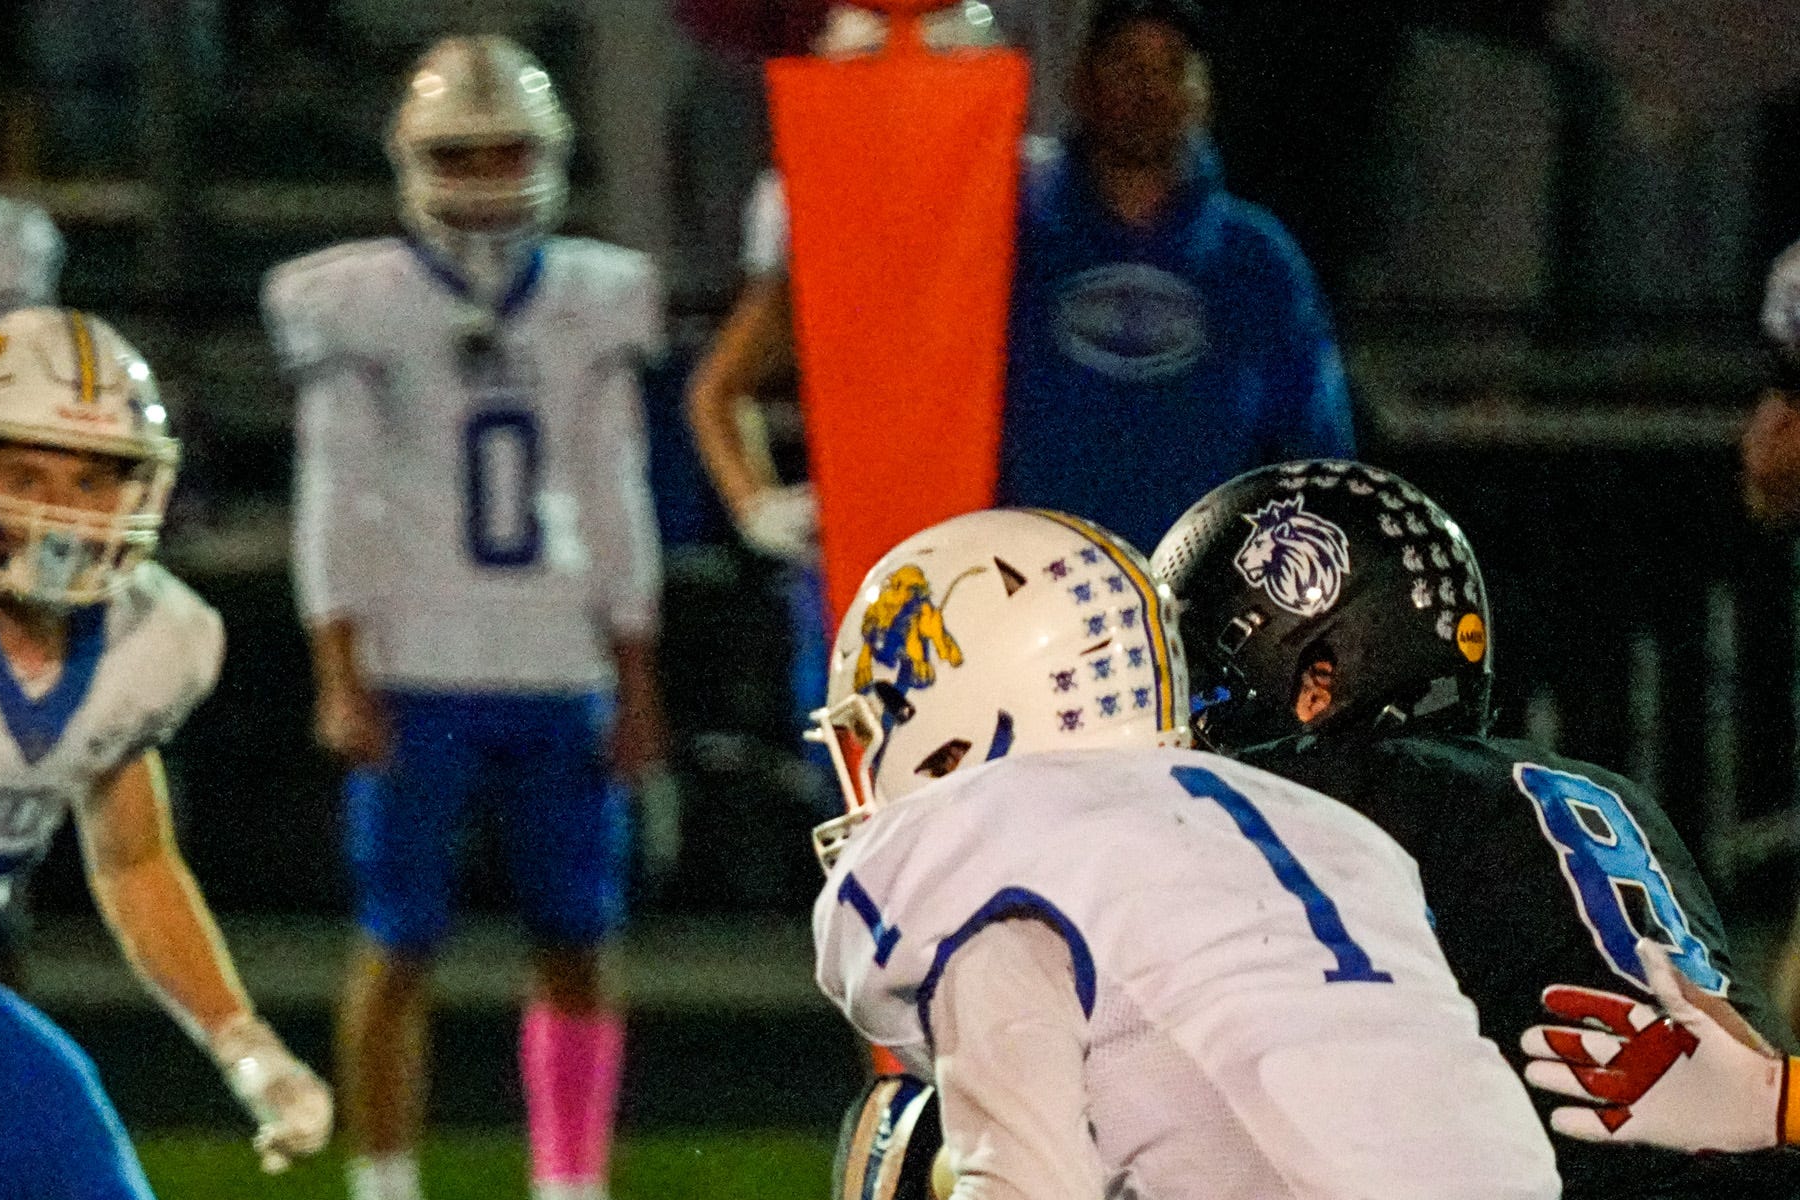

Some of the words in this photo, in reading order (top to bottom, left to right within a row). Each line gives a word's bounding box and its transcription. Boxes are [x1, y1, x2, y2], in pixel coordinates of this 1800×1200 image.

[463, 408, 546, 569] 0
[837, 872, 901, 970] 1
[1170, 765, 1393, 983] 1
